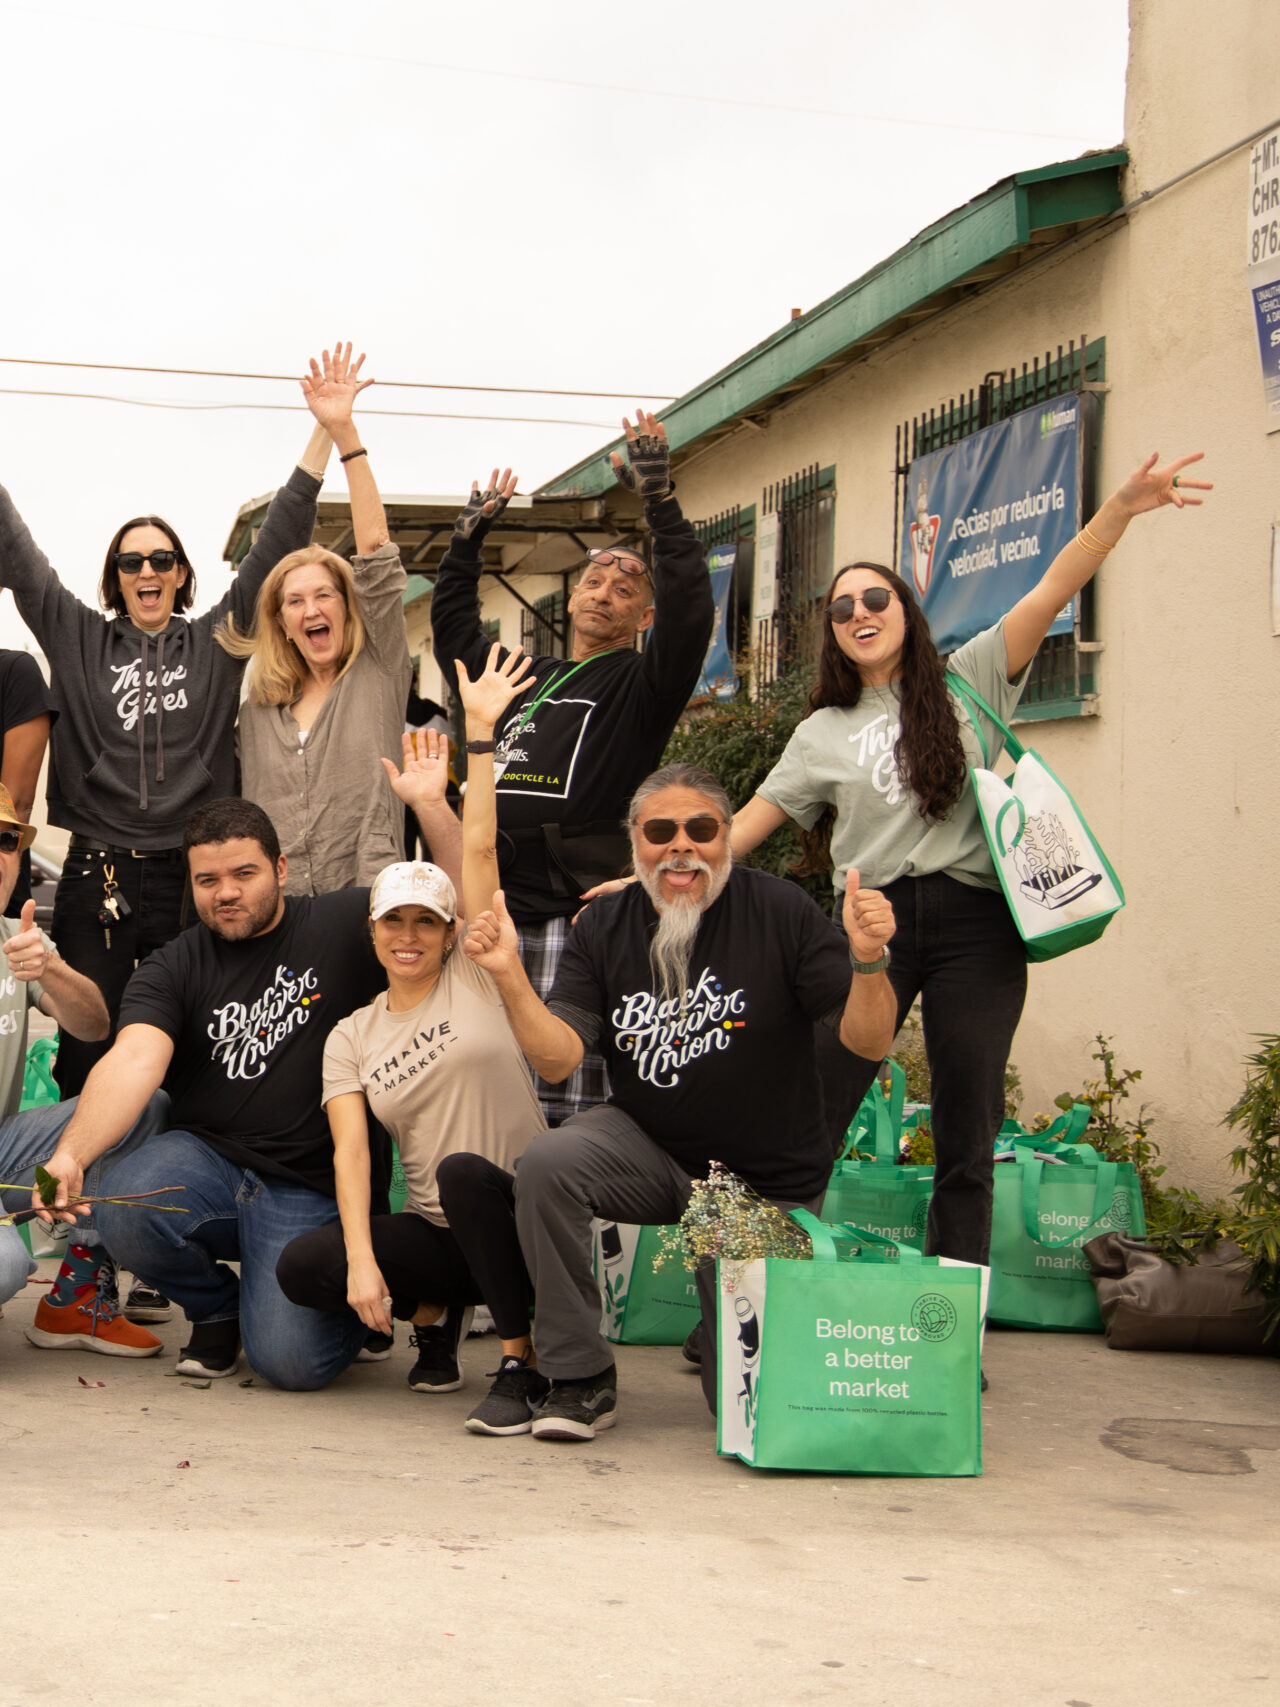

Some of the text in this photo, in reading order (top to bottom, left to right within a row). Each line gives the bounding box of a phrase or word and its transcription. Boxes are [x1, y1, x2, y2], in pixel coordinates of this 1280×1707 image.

[1262, 135, 1280, 172] MT.
[990, 503, 1010, 535] por
[1010, 485, 1052, 523] reducir
[1052, 481, 1064, 511] la
[1000, 531, 1040, 564] vecino.
[546, 776, 560, 785] LA
[612, 966, 721, 1030] Black
[227, 1006, 310, 1080] Union
[615, 989, 746, 1061] Thriver
[384, 1042, 446, 1092] MARKET
[638, 1027, 731, 1088] Union
[1035, 1254, 1092, 1271] marke
[816, 1318, 920, 1346] Belong to
[825, 1347, 912, 1370] a better
[829, 1377, 910, 1399] market
